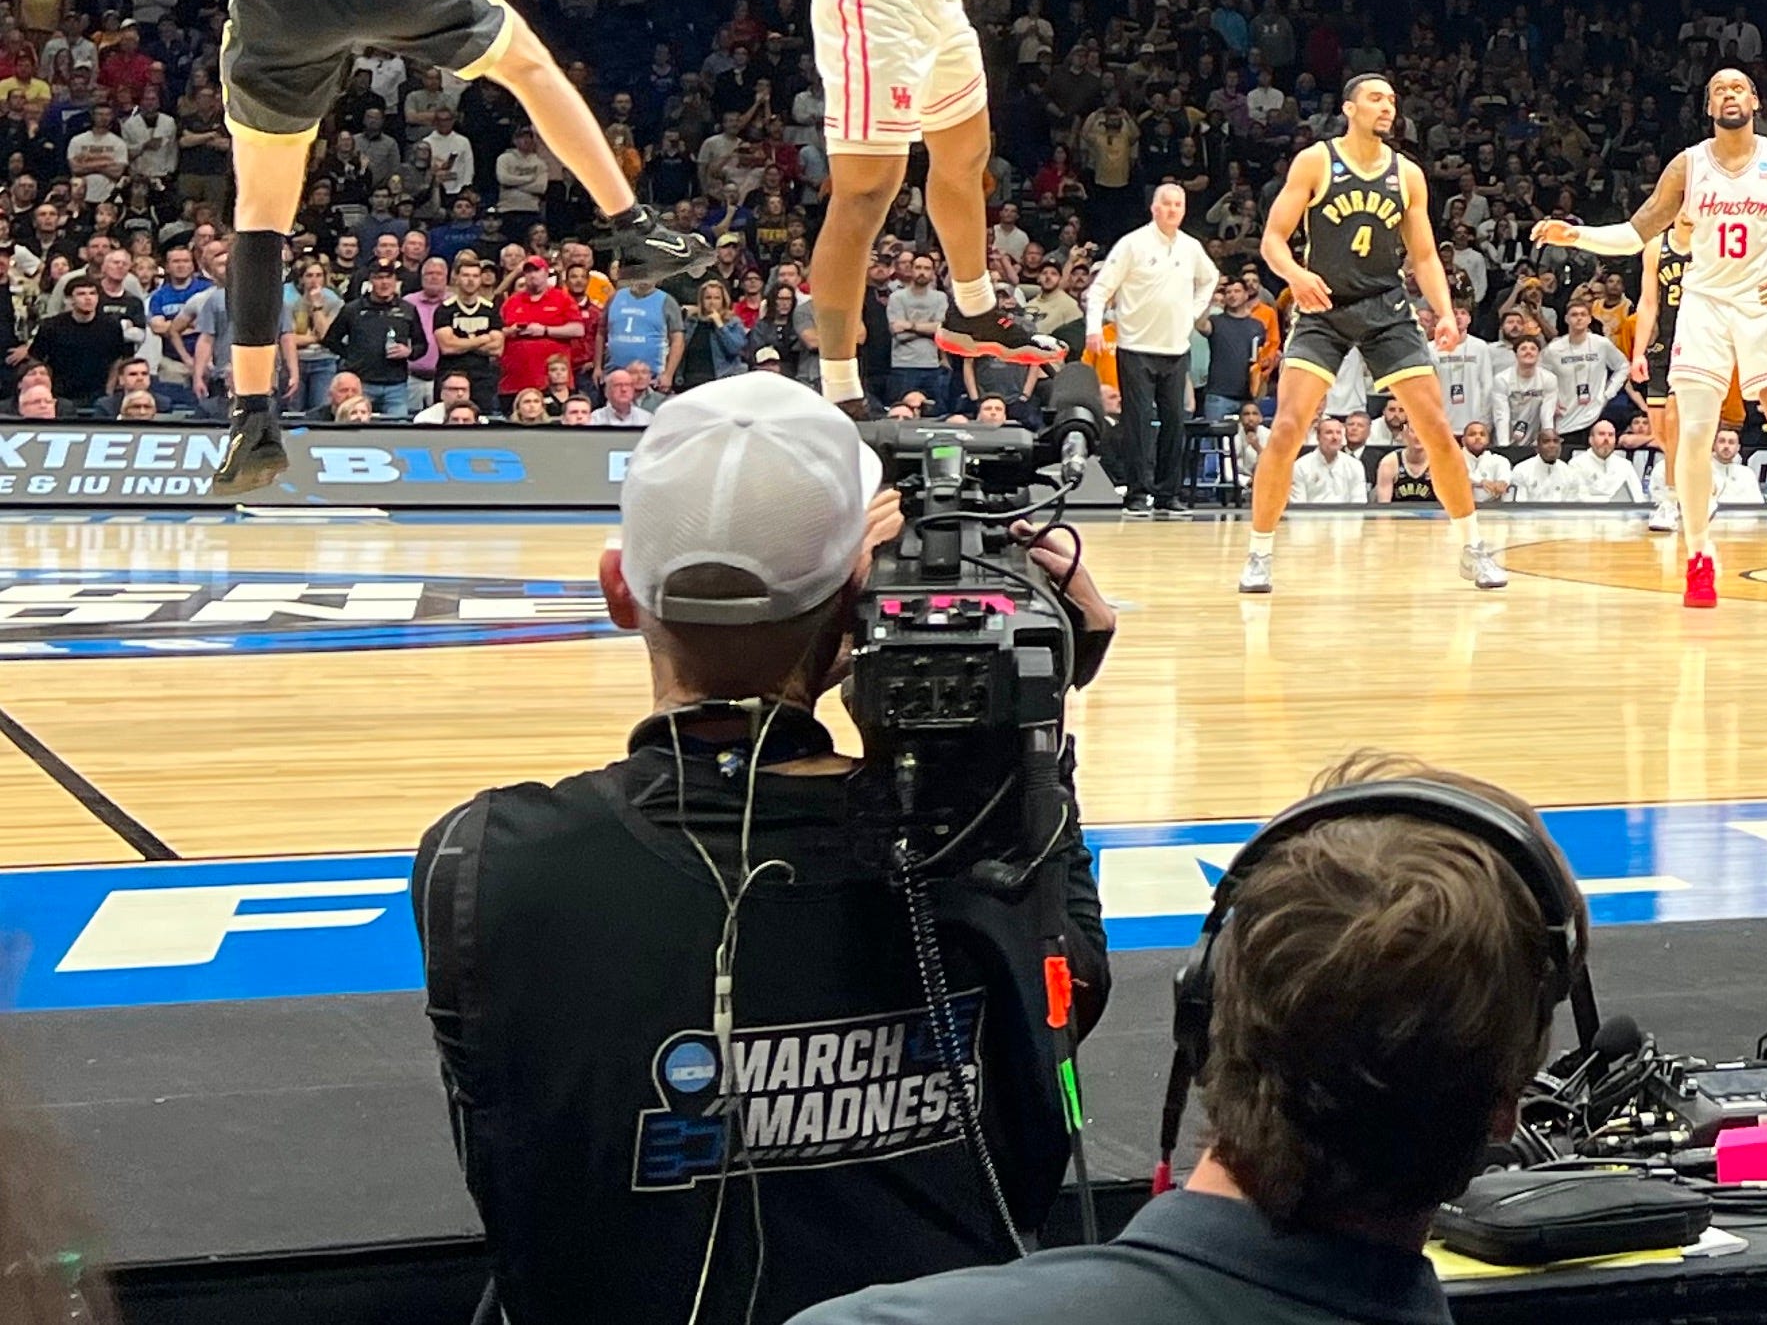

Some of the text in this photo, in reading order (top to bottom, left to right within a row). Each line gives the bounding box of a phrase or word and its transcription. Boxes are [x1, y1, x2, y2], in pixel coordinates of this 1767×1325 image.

[1322, 190, 1402, 229] PURDUE
[1350, 225, 1372, 257] 4
[1717, 222, 1748, 259] 13
[27, 475, 57, 494] &
[68, 476, 111, 494] IU
[121, 476, 214, 495] INDY
[719, 1024, 906, 1095] MARCH
